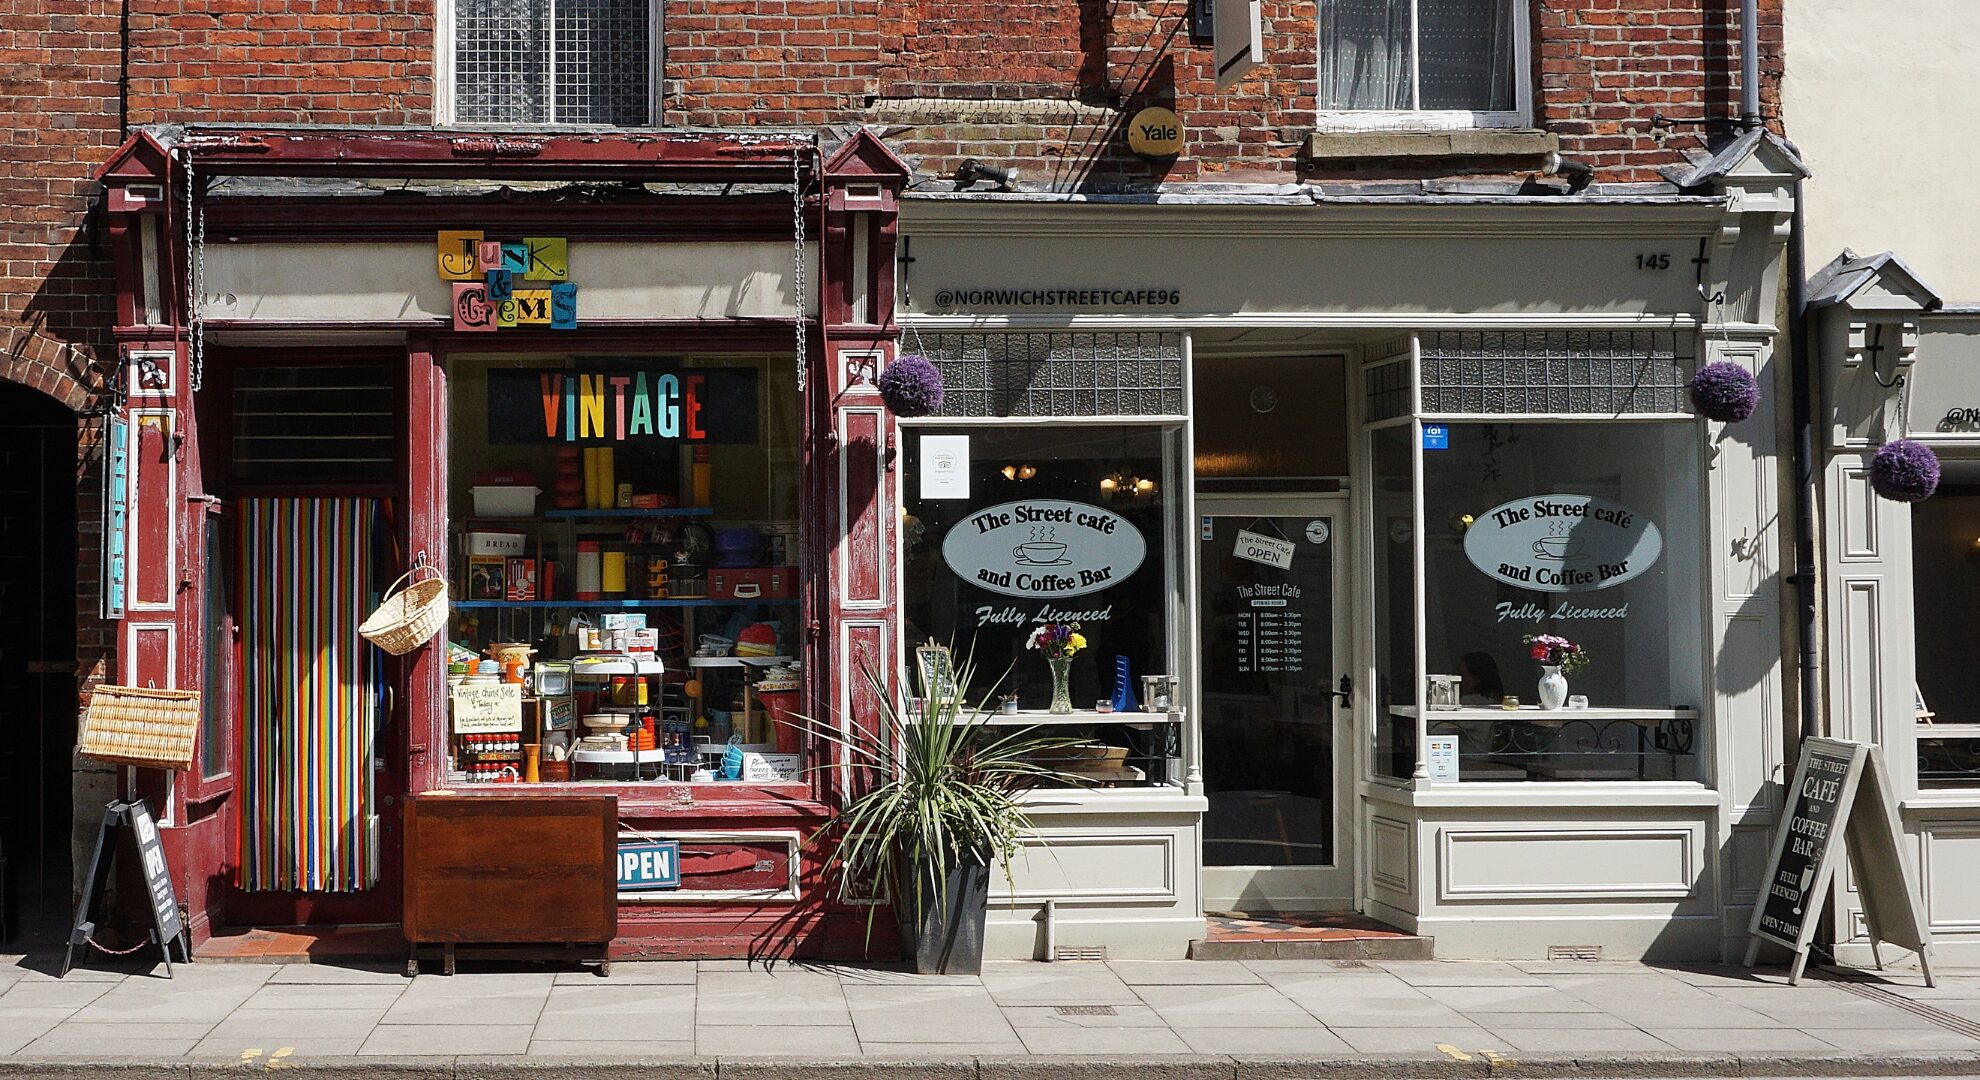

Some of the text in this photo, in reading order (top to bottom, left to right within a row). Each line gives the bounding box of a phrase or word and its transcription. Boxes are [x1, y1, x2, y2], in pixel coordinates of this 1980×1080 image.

[1140, 125, 1177, 141] Yale
[1636, 254, 1670, 270] 145
[491, 269, 509, 298] &
[935, 289, 1180, 307] @NORWICHSTREETCAFE96
[540, 371, 706, 442] VINTAGE
[1947, 407, 1980, 424] @N
[971, 505, 1118, 535] The Street café
[1492, 500, 1634, 529] The Street café
[485, 540, 518, 548] BREAD
[1255, 537, 1276, 547] Street
[1247, 546, 1280, 562] OPEN
[977, 565, 1112, 591] and Coffee Bar
[1498, 560, 1629, 585] and Coffee Bar
[1236, 585, 1254, 599] The
[1254, 583, 1280, 596] Street
[975, 604, 1113, 628] Fully Licenced
[1495, 601, 1629, 623] Fully Licenced
[1809, 758, 1848, 774] THE STREET
[1802, 776, 1840, 803] CAFÉ
[1808, 805, 1820, 813] AND
[1791, 816, 1828, 839] COFFEE
[1792, 837, 1813, 857] BAR
[1780, 870, 1799, 885] FULLY
[1771, 883, 1799, 901] LICENCED
[1762, 914, 1799, 937] OPEN 7 DAYS
